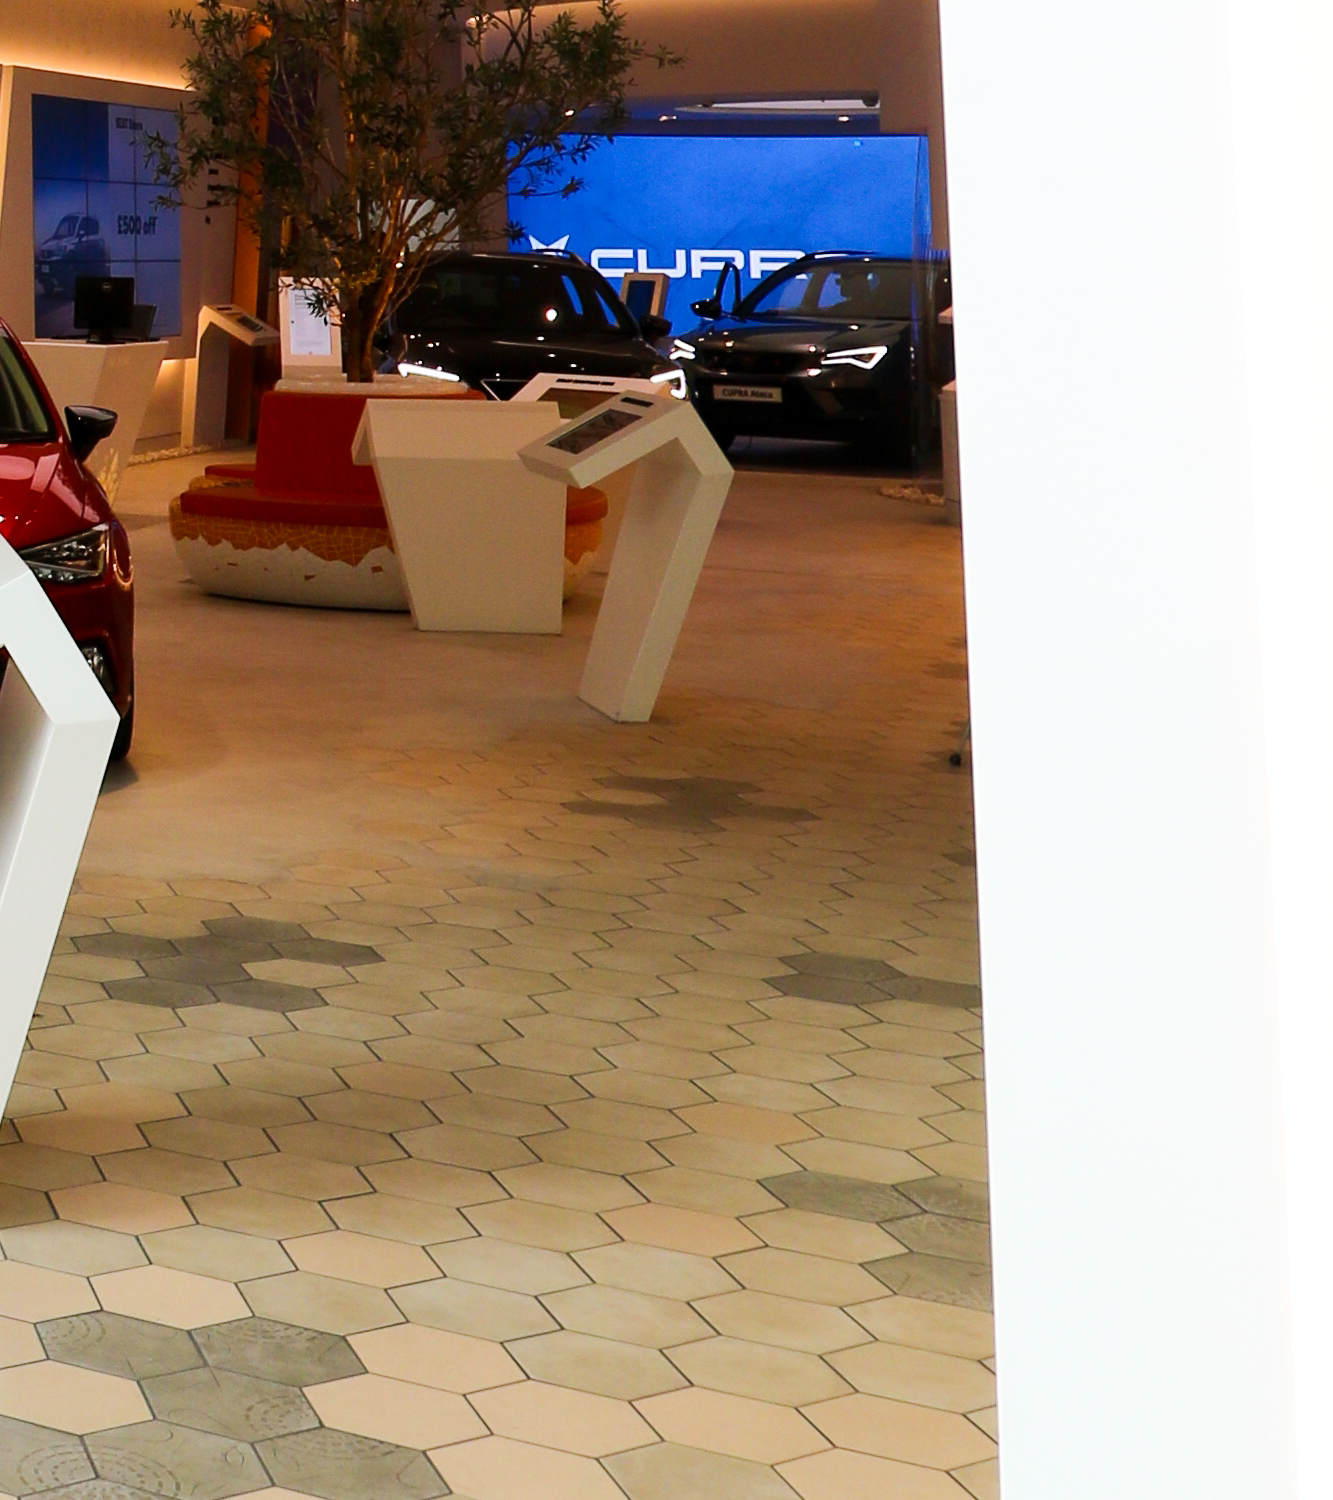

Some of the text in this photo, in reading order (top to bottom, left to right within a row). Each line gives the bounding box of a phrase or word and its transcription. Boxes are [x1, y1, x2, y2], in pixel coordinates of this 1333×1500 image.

[117, 214, 159, 236] £500 off
[590, 248, 809, 280] CUPR
